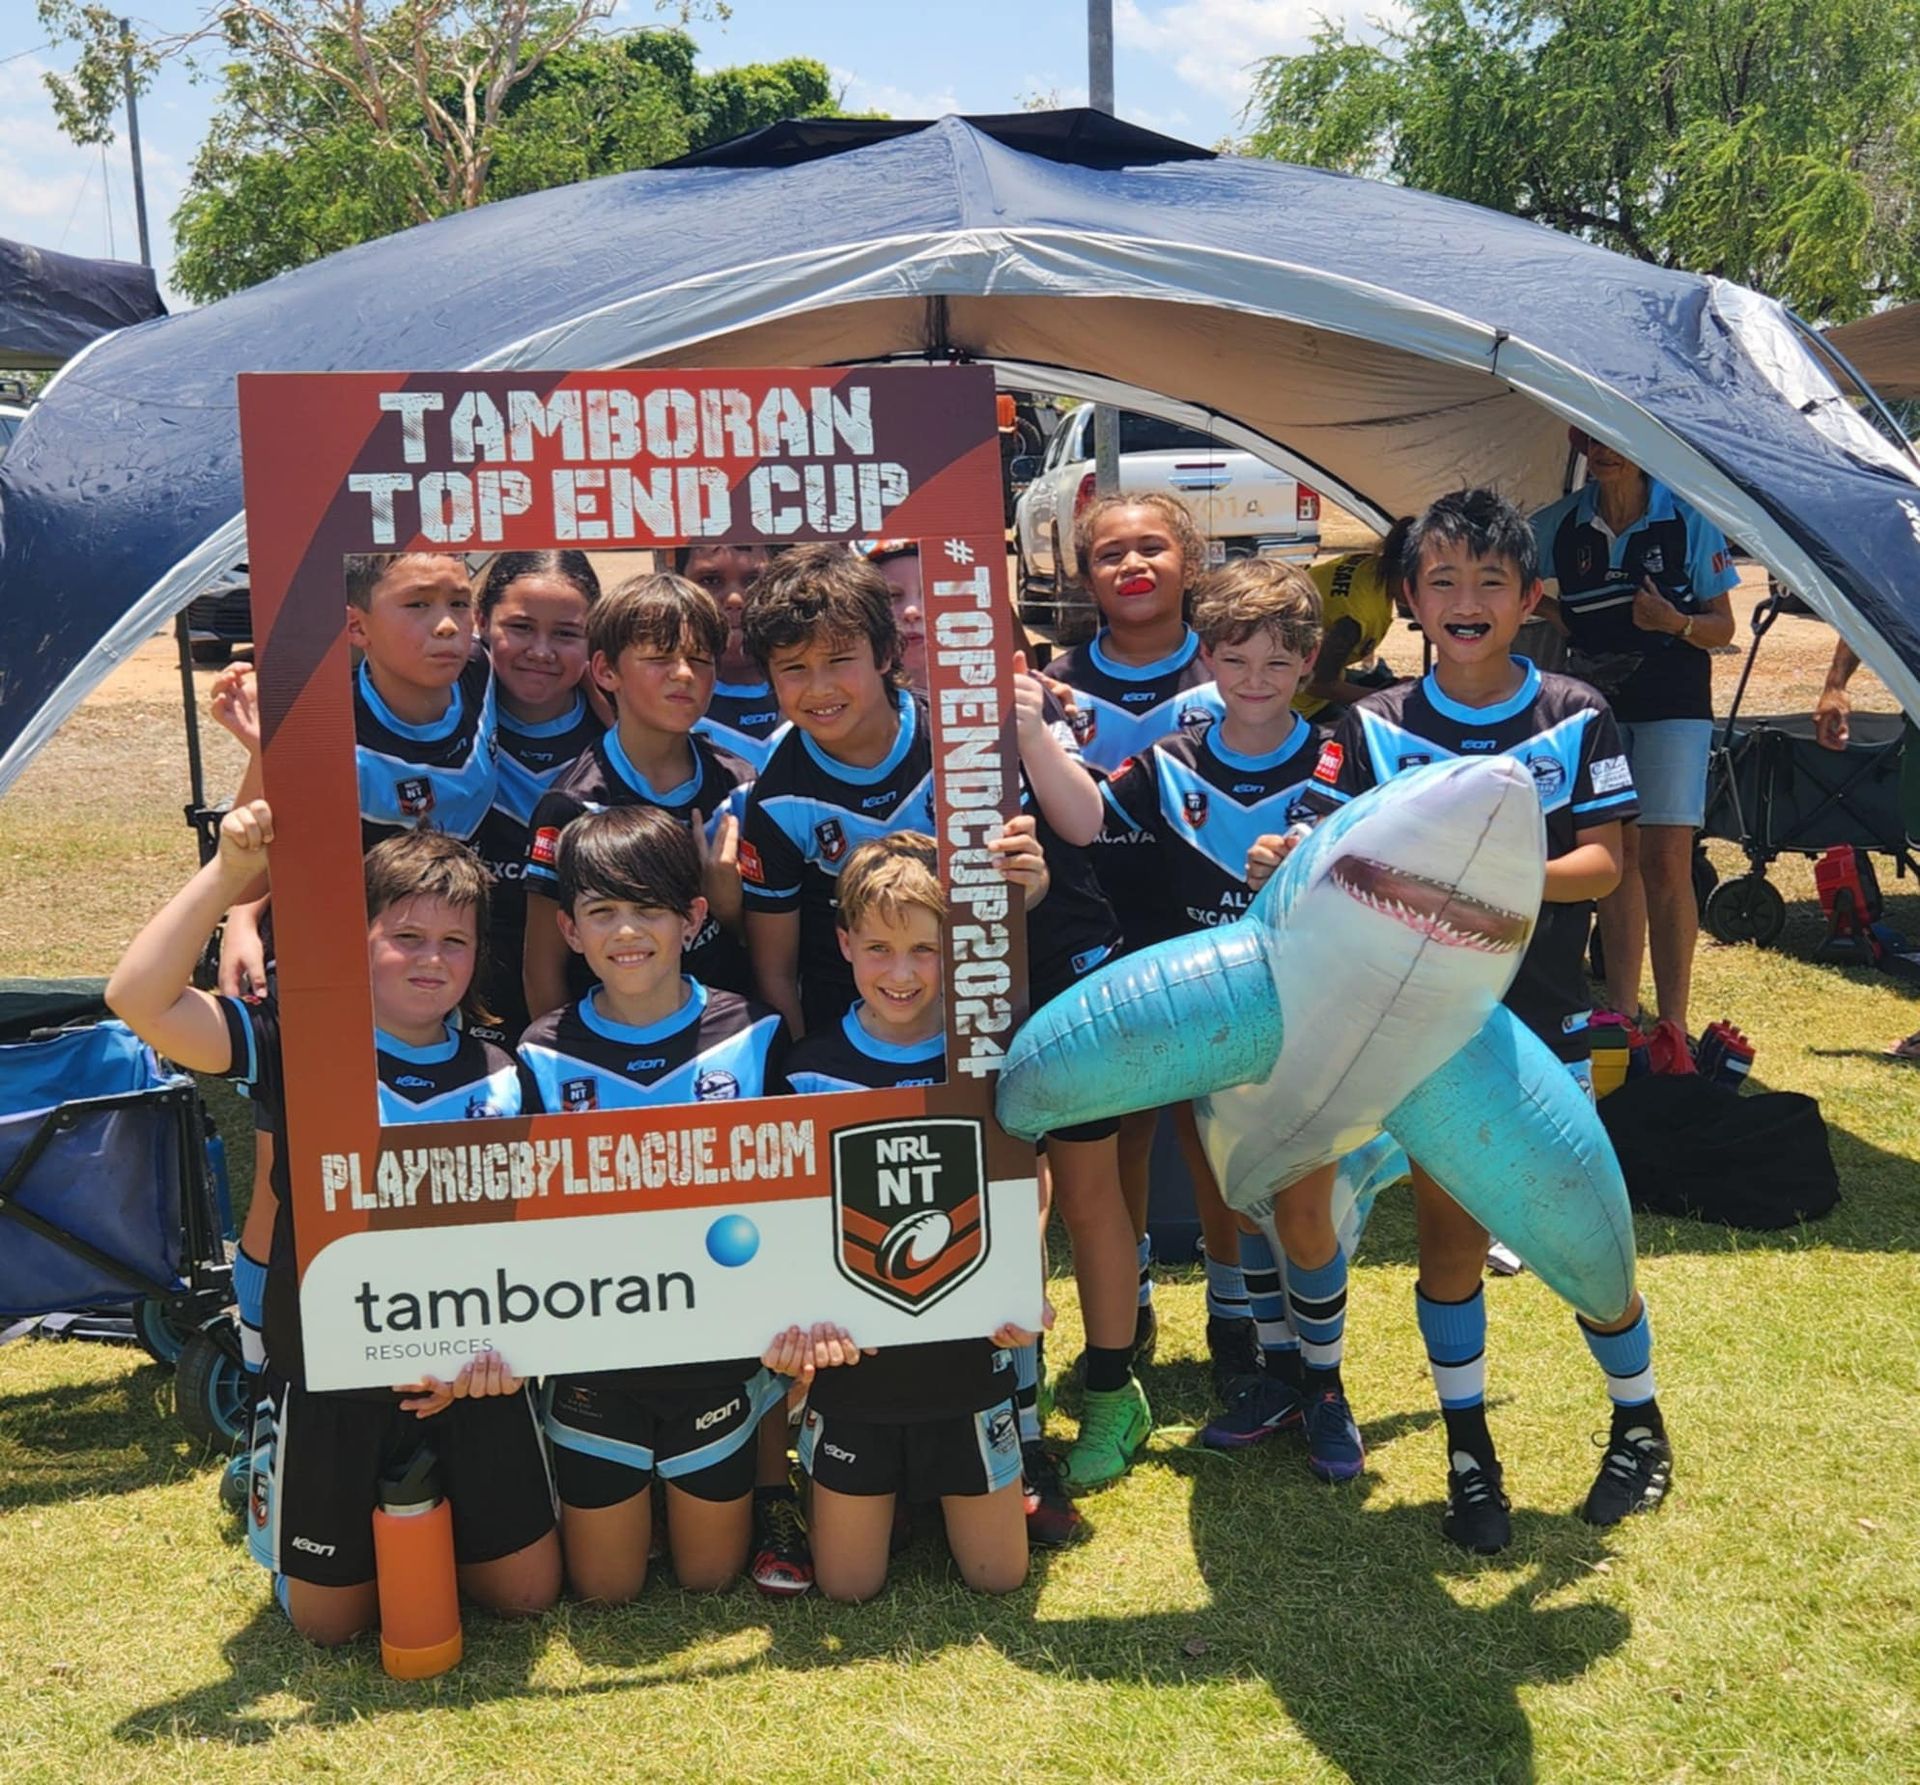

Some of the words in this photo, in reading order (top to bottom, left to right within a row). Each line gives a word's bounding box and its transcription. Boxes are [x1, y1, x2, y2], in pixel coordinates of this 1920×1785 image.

[380, 386, 874, 463] TAMBORAN
[349, 470, 533, 544] TOP
[552, 467, 731, 539] END
[750, 462, 908, 538] CUP
[934, 539, 1012, 1078] #TOPENDCUP2024
[322, 1118, 816, 1211] PLAYRUGBYLEAGUE.COM
[876, 1134, 941, 1164] NRL
[877, 1165, 943, 1207] NT
[355, 1268, 696, 1333] tamboran
[366, 1338, 494, 1361] RESOURCES
